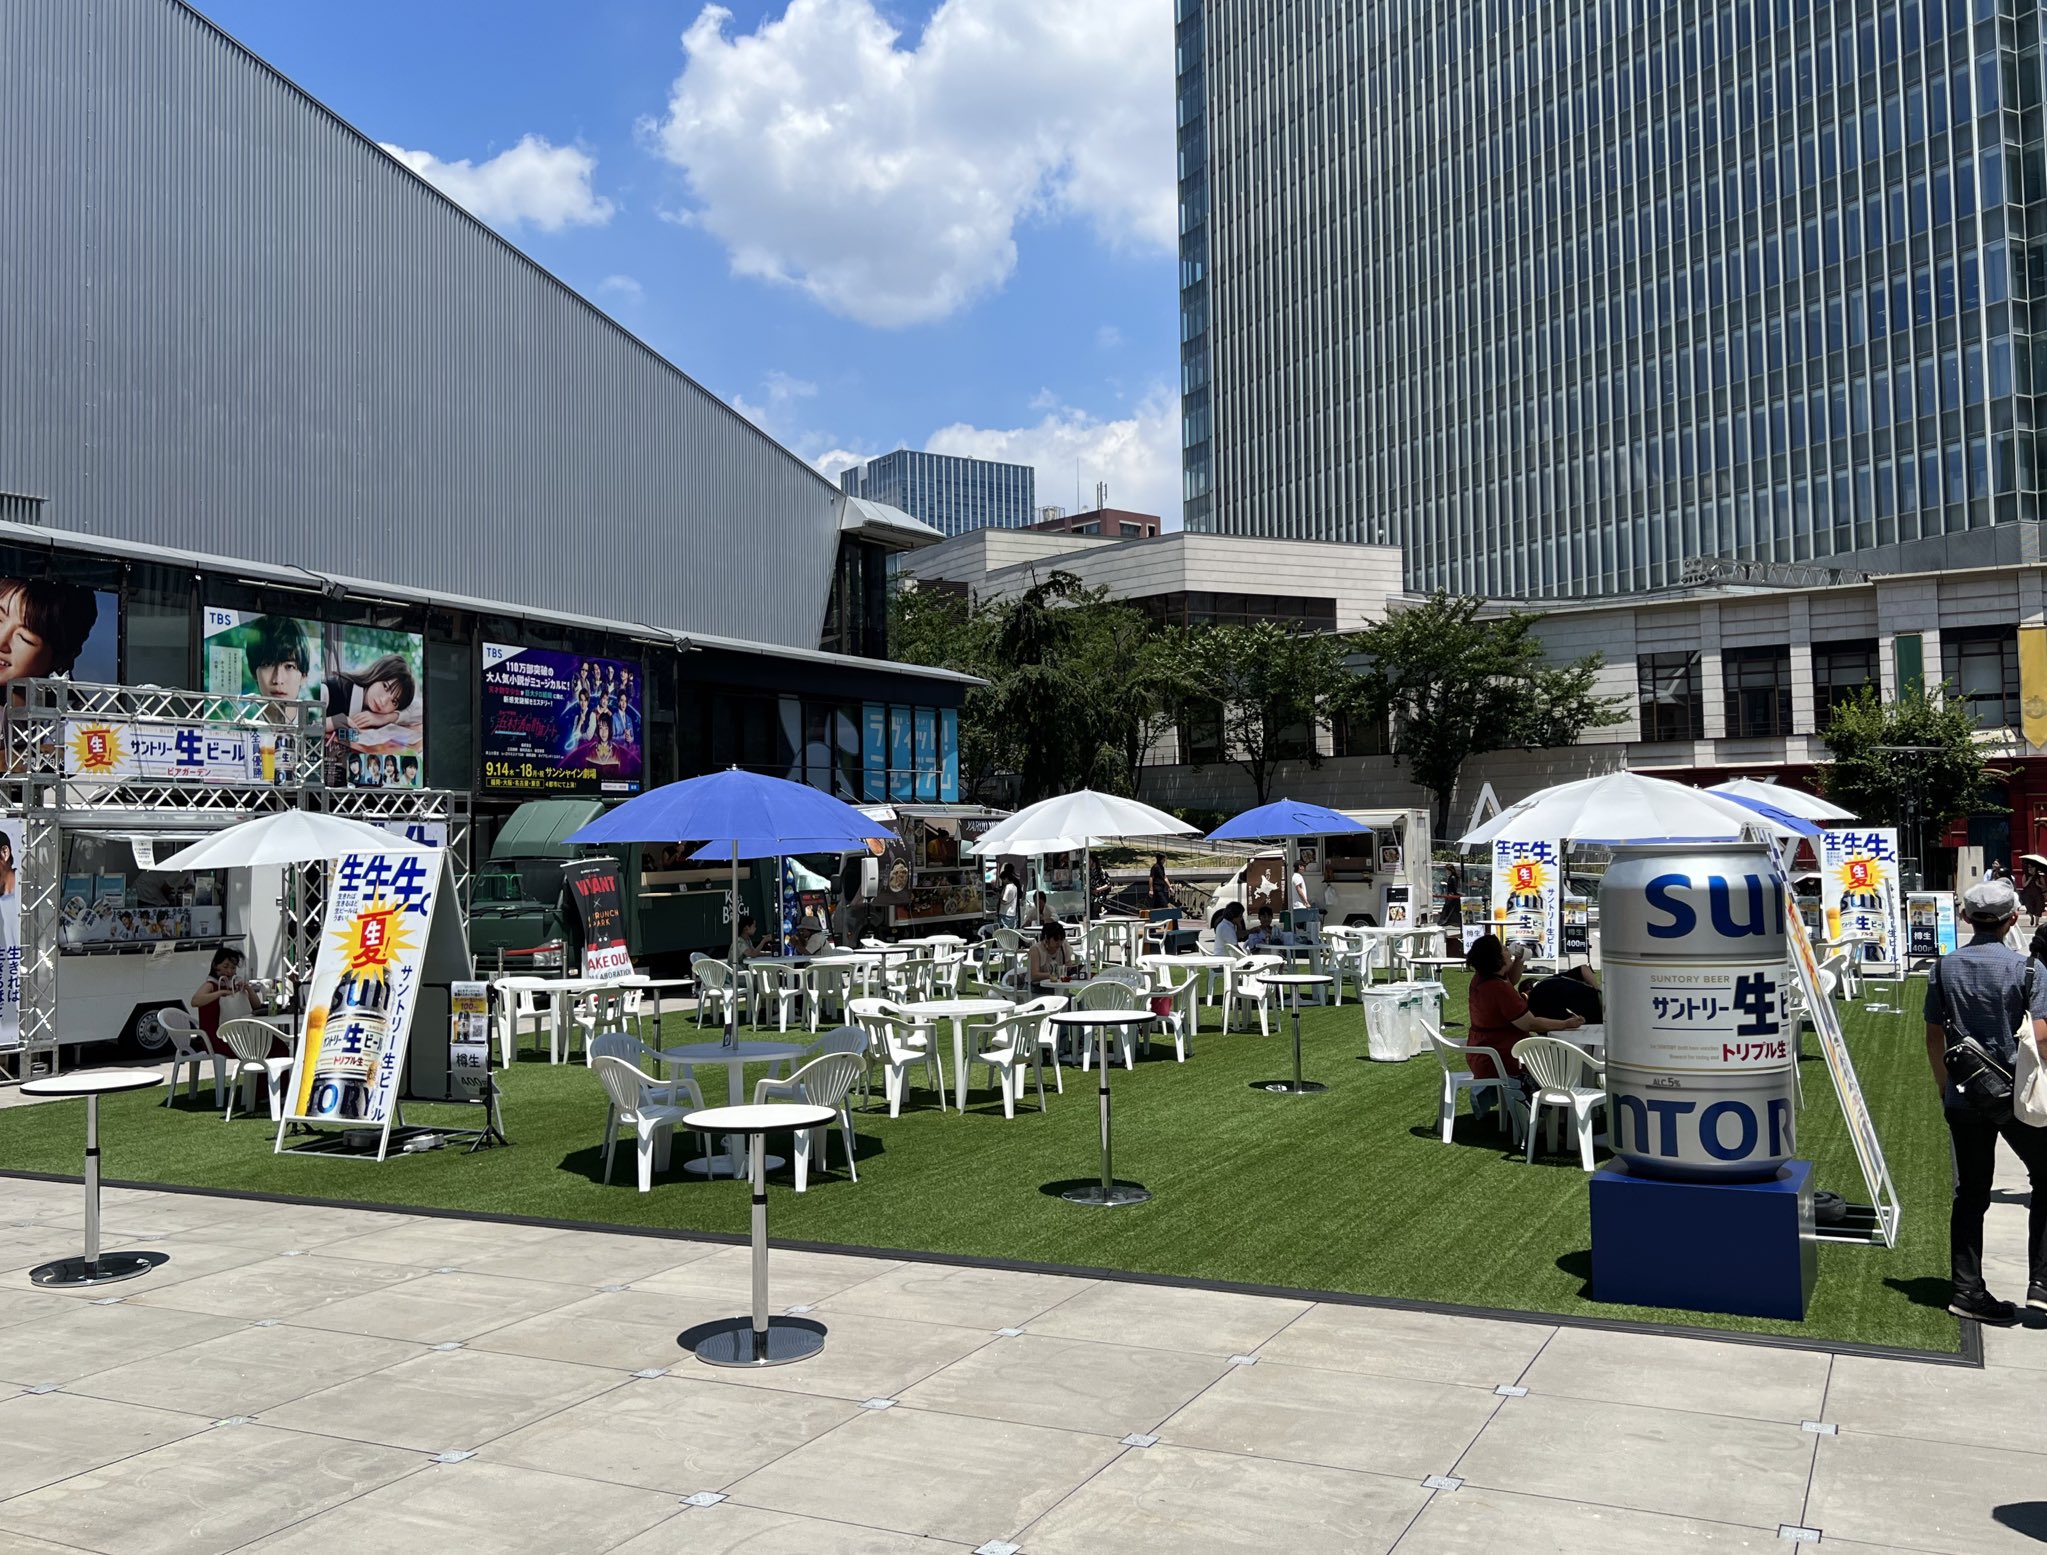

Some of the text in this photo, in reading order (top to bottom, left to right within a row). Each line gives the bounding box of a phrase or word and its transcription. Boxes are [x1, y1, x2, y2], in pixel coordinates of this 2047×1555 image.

[209, 612, 231, 626] TBS
[486, 647, 503, 659] TBS
[505, 661, 554, 677] 110万部突破の
[90, 736, 103, 752] 生
[167, 767, 212, 776] ビアガーデン
[1519, 868, 1531, 880] 生
[1852, 865, 1866, 878] 生
[365, 920, 382, 945] 生
[1913, 931, 1932, 941] 樽生
[1566, 940, 1586, 948] 400円
[6, 946, 21, 1003] 生きれば
[1650, 974, 1731, 984] SUNTORY BEER
[371, 965, 413, 1122] サントリー生ビール
[1722, 1039, 1787, 1063] トリプル生
[333, 1056, 365, 1067] トリプル生
[456, 1052, 481, 1068] 樽生
